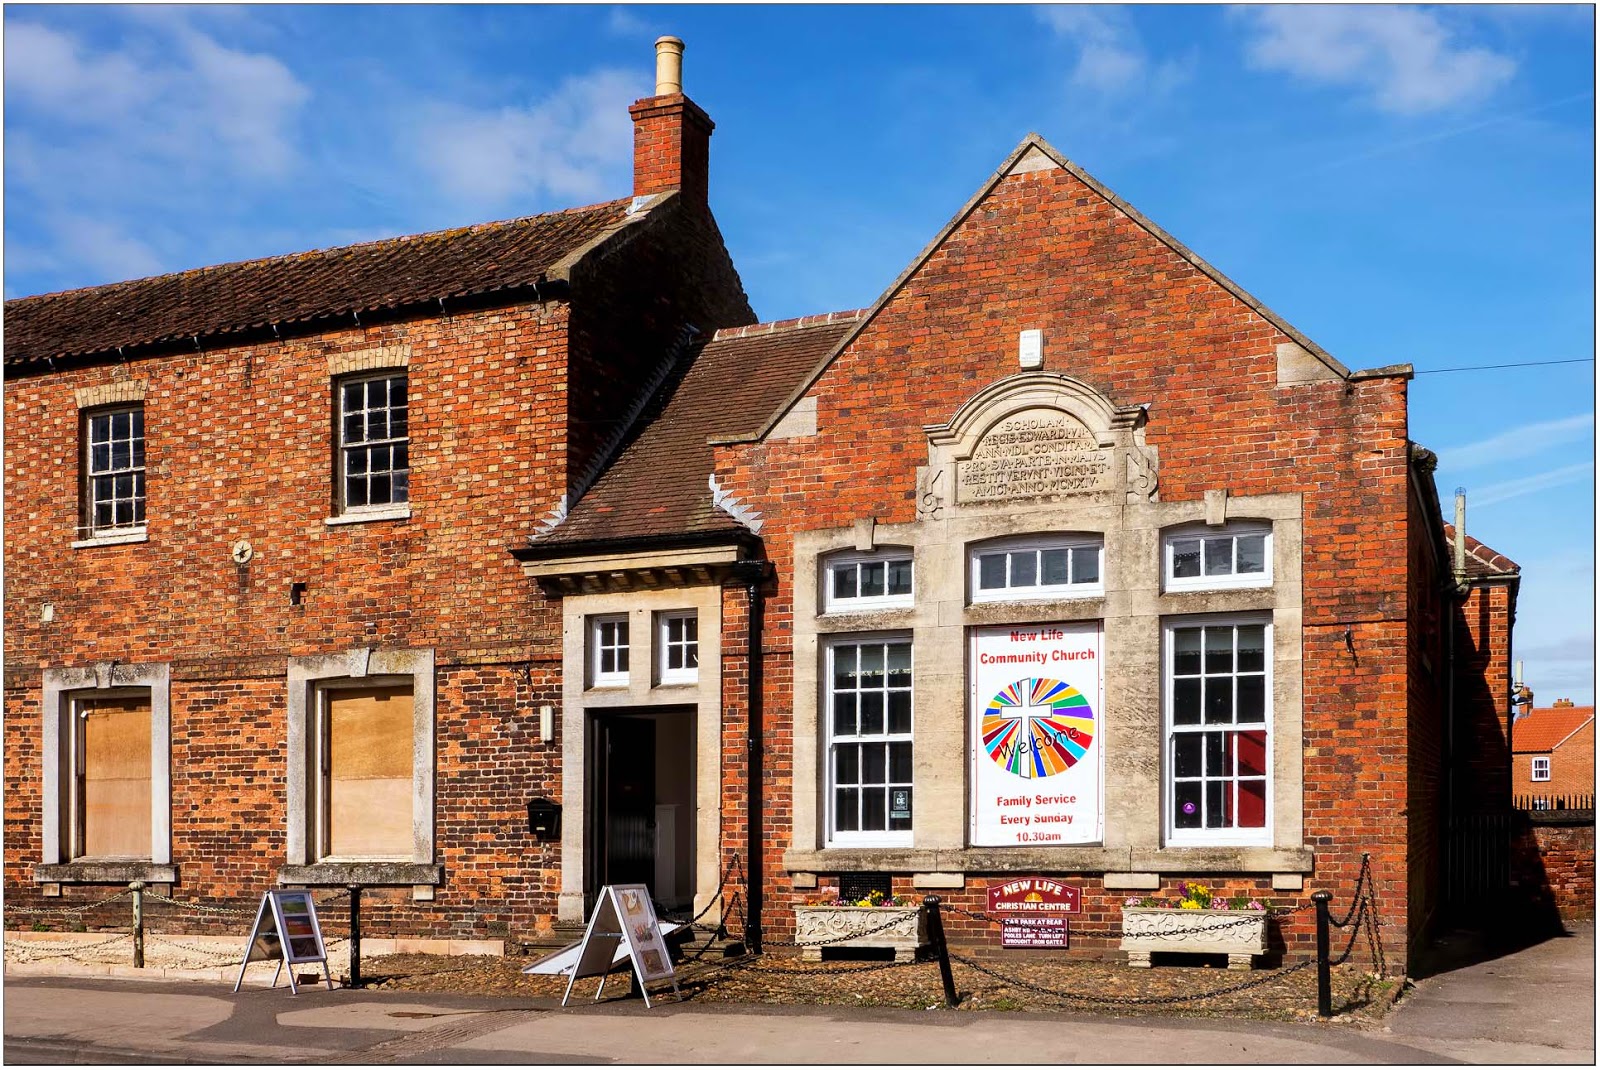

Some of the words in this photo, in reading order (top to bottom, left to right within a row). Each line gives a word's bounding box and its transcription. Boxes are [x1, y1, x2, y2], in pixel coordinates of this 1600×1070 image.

[1005, 417, 1065, 432] SCHOLAM
[965, 461, 987, 473] PRO
[1010, 630, 1037, 642] New
[1041, 629, 1064, 641] Life
[980, 651, 1047, 665] Community
[1051, 648, 1095, 661] Church
[997, 727, 1081, 760] Welcome
[996, 795, 1032, 808] Family
[1035, 794, 1076, 805] Service
[1000, 815, 1030, 826] Every
[1034, 813, 1073, 825] Sunday
[1016, 831, 1061, 842] 10.30am
[1002, 880, 1031, 897] NEW
[1034, 880, 1063, 896] LIFE
[995, 902, 1037, 911] CHRISTIAN
[1038, 903, 1071, 911] CENTRE
